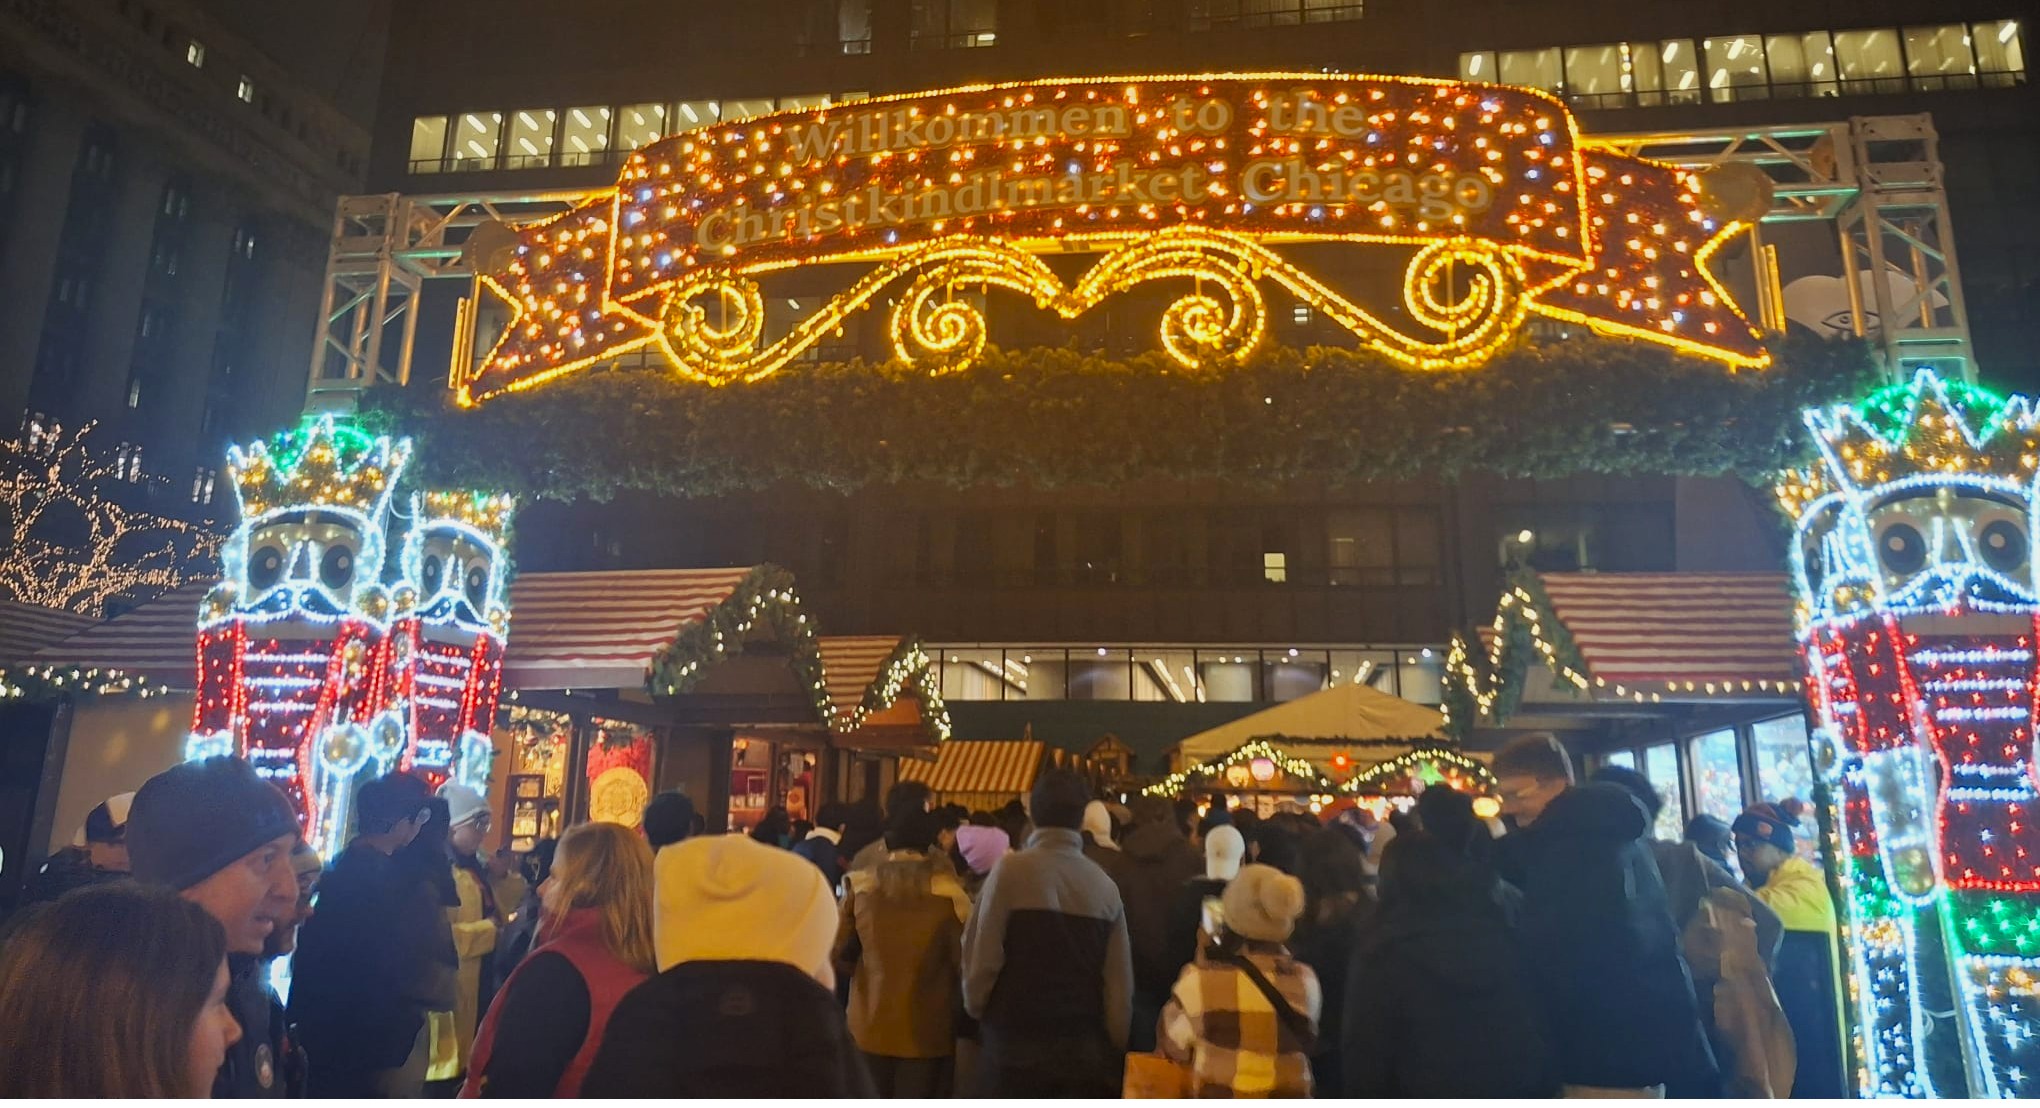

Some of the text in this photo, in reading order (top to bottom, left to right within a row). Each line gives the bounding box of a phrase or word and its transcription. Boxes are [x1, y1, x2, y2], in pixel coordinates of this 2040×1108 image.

[785, 90, 1366, 163] Willkommen to the
[698, 159, 1489, 251] Christkindlmarket Chicago
